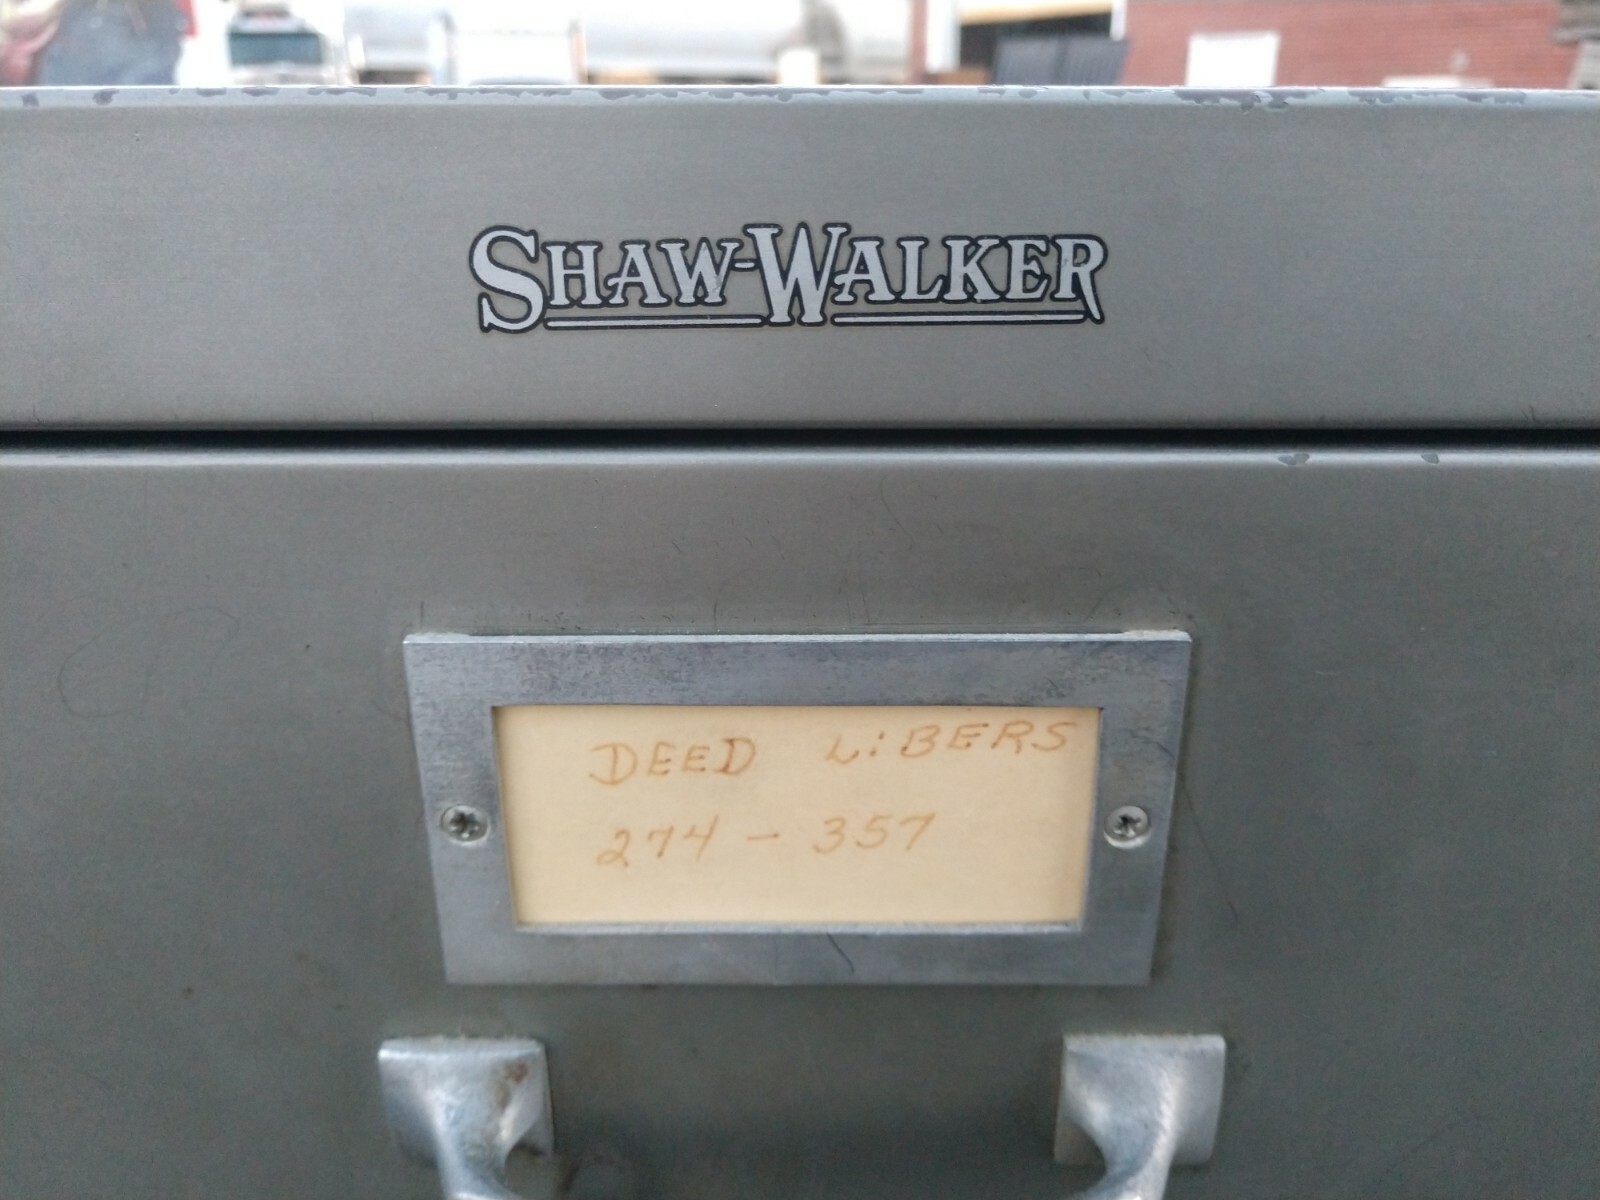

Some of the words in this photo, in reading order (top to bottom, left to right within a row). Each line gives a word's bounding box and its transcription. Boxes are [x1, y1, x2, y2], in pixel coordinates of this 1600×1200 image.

[469, 223, 1108, 333] SHAW-WALKER
[589, 736, 756, 786] DEED
[596, 814, 719, 867] 274
[812, 812, 936, 854] 357
